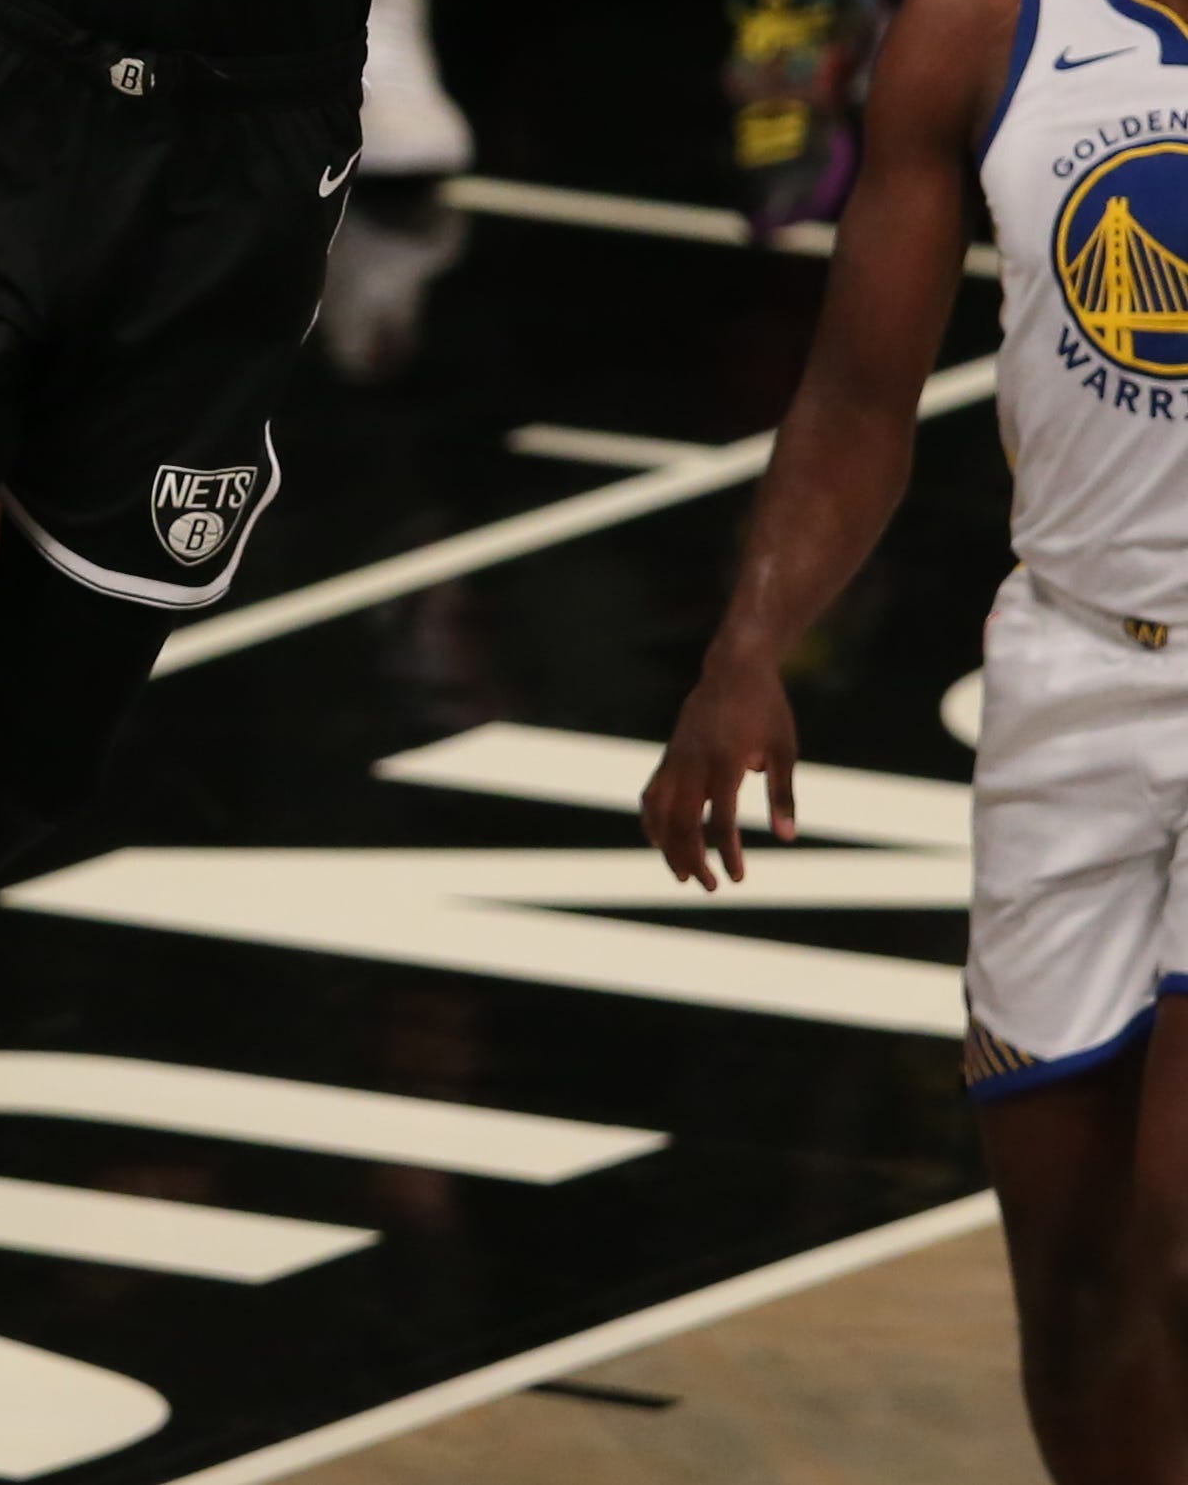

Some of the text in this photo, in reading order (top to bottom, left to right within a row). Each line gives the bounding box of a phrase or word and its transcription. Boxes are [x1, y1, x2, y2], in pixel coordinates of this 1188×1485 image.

[121, 64, 139, 90] B
[1053, 110, 1188, 179] GOLDEN
[157, 472, 251, 509] NETS
[185, 519, 208, 550] B
